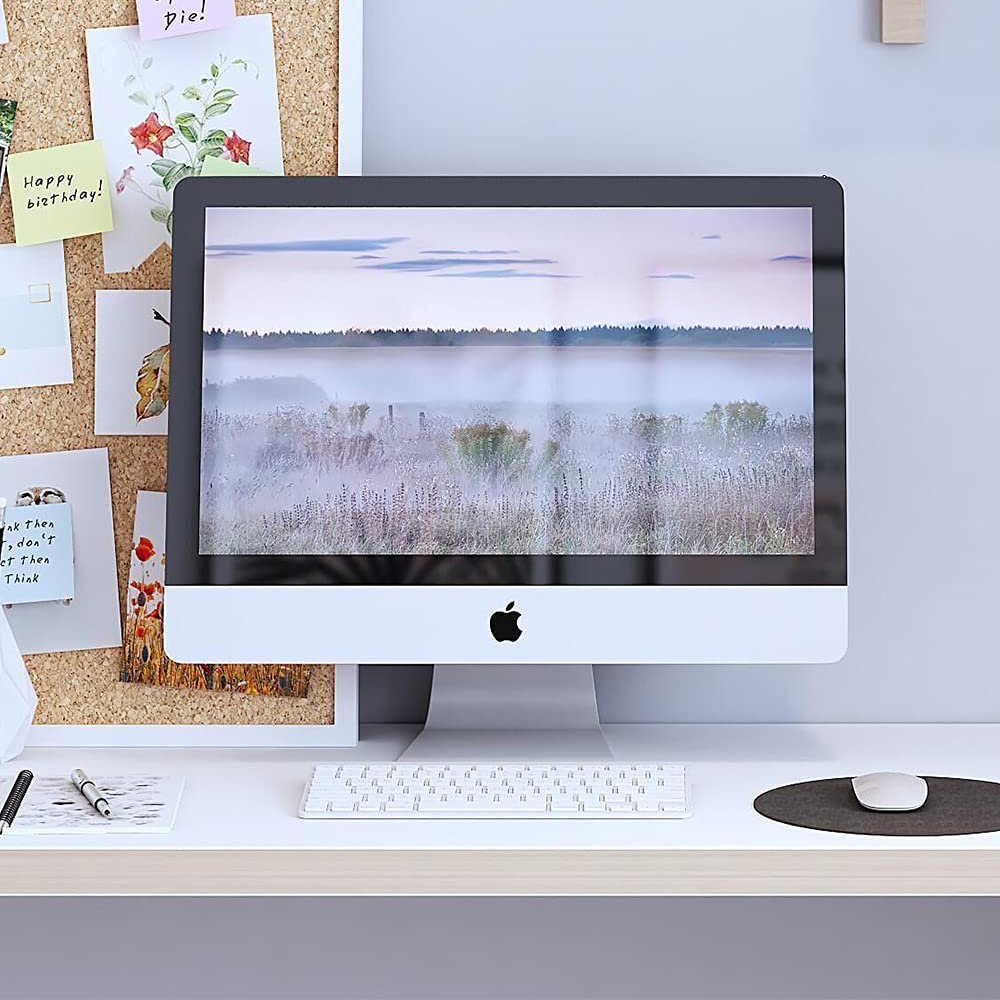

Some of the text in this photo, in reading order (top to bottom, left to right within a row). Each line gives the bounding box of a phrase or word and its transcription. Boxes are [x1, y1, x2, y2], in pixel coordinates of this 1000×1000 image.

[24, 174, 74, 189] Happy
[27, 180, 103, 209] birthday!
[4, 573, 40, 585] Think
